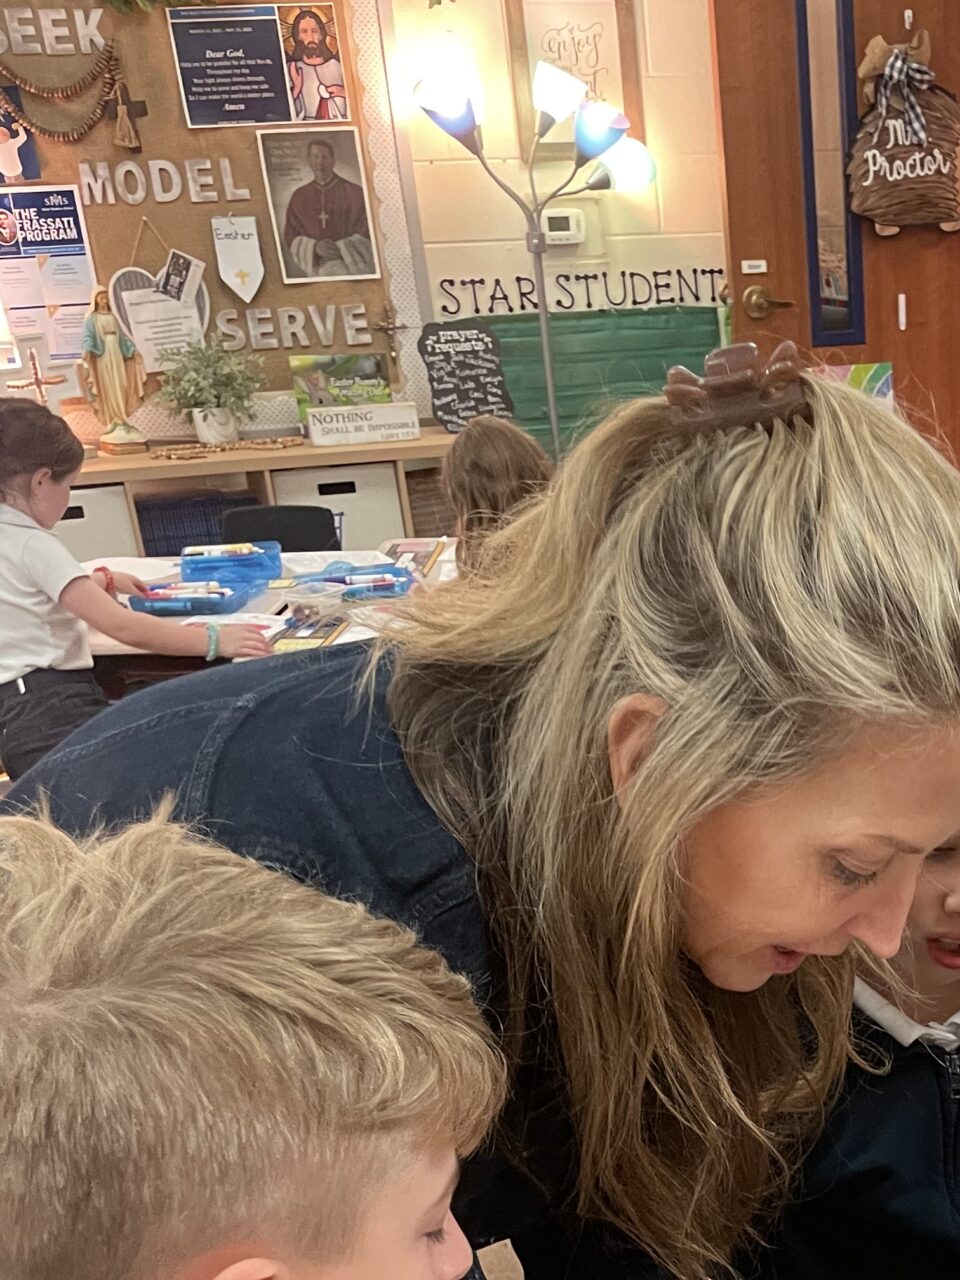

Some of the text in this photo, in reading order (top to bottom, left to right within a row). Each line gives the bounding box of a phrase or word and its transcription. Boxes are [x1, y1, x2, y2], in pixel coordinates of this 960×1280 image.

[206, 50, 225, 58] Dear
[862, 148, 950, 186] Proctor
[79, 157, 251, 206] MODEL
[14, 208, 39, 220] THE
[16, 217, 75, 231] FRASSATI
[18, 227, 79, 242] PROGRAM
[439, 268, 723, 315] STAR STUDENT
[215, 303, 373, 351] SERVE
[438, 329, 480, 343] prayer
[311, 411, 373, 426] NOTHING
